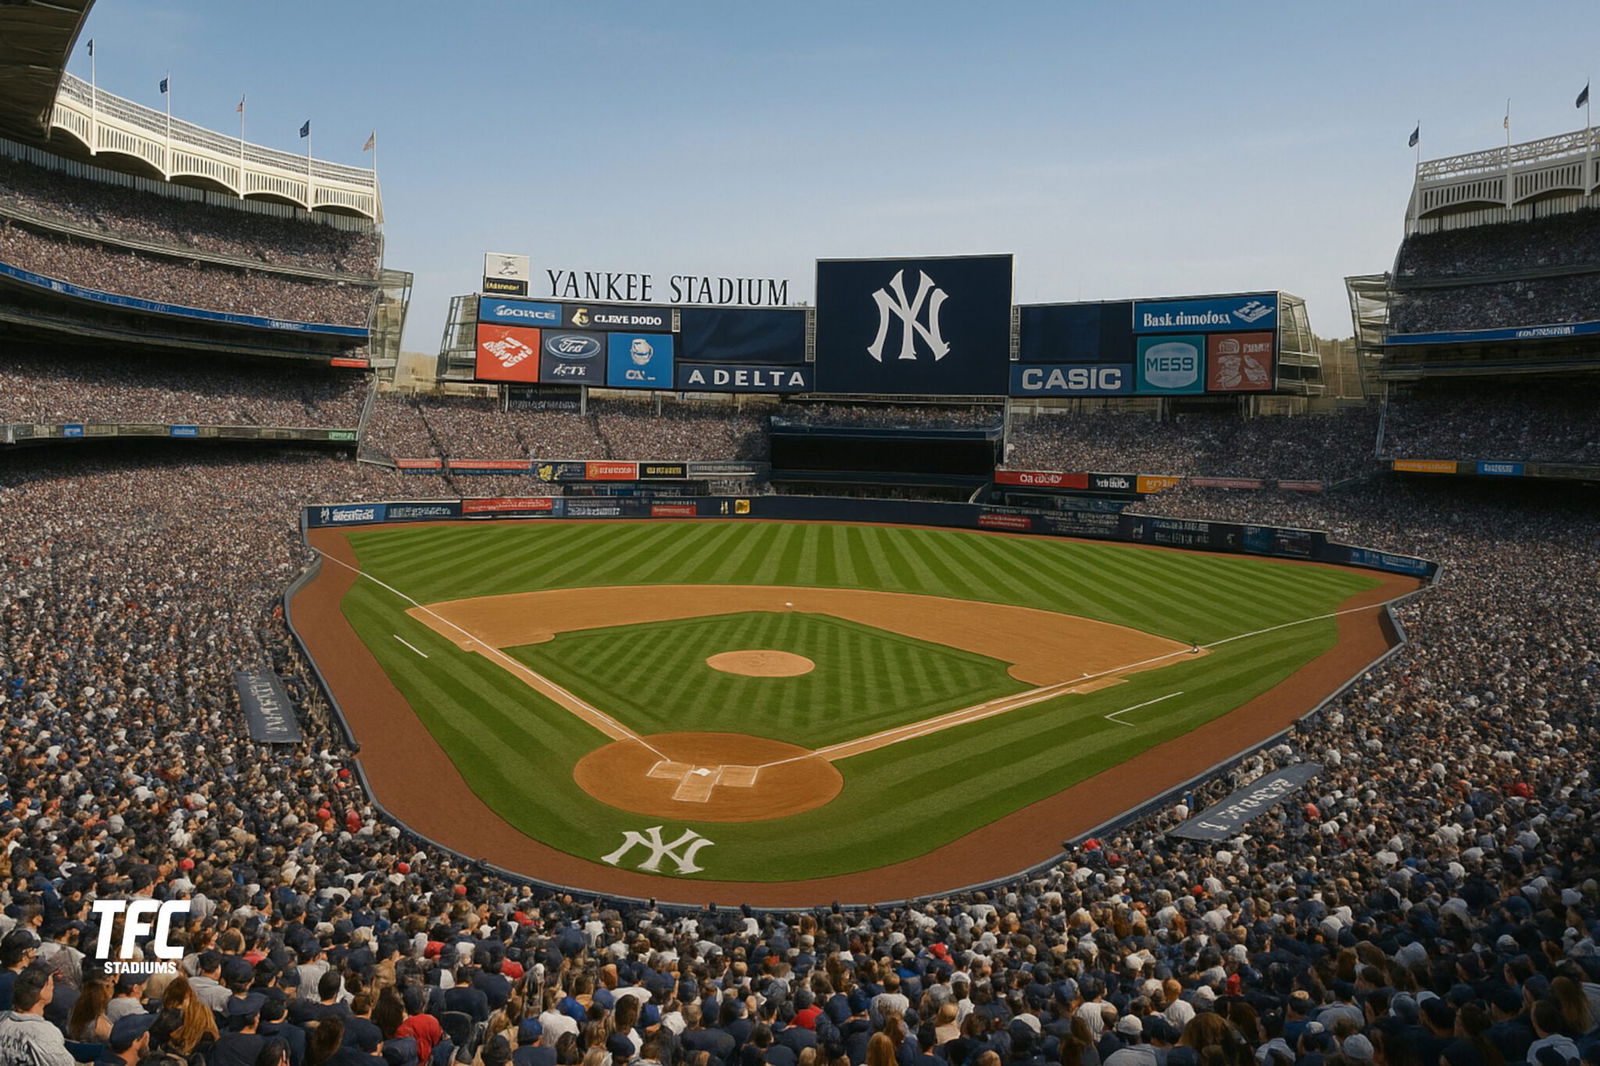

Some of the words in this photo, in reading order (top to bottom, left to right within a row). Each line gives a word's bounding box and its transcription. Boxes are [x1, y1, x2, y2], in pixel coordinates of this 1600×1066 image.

[546, 269, 652, 301] YANKEE
[670, 275, 789, 306] STADIUM
[631, 315, 662, 326] DODO
[1022, 368, 1121, 390] CASIC
